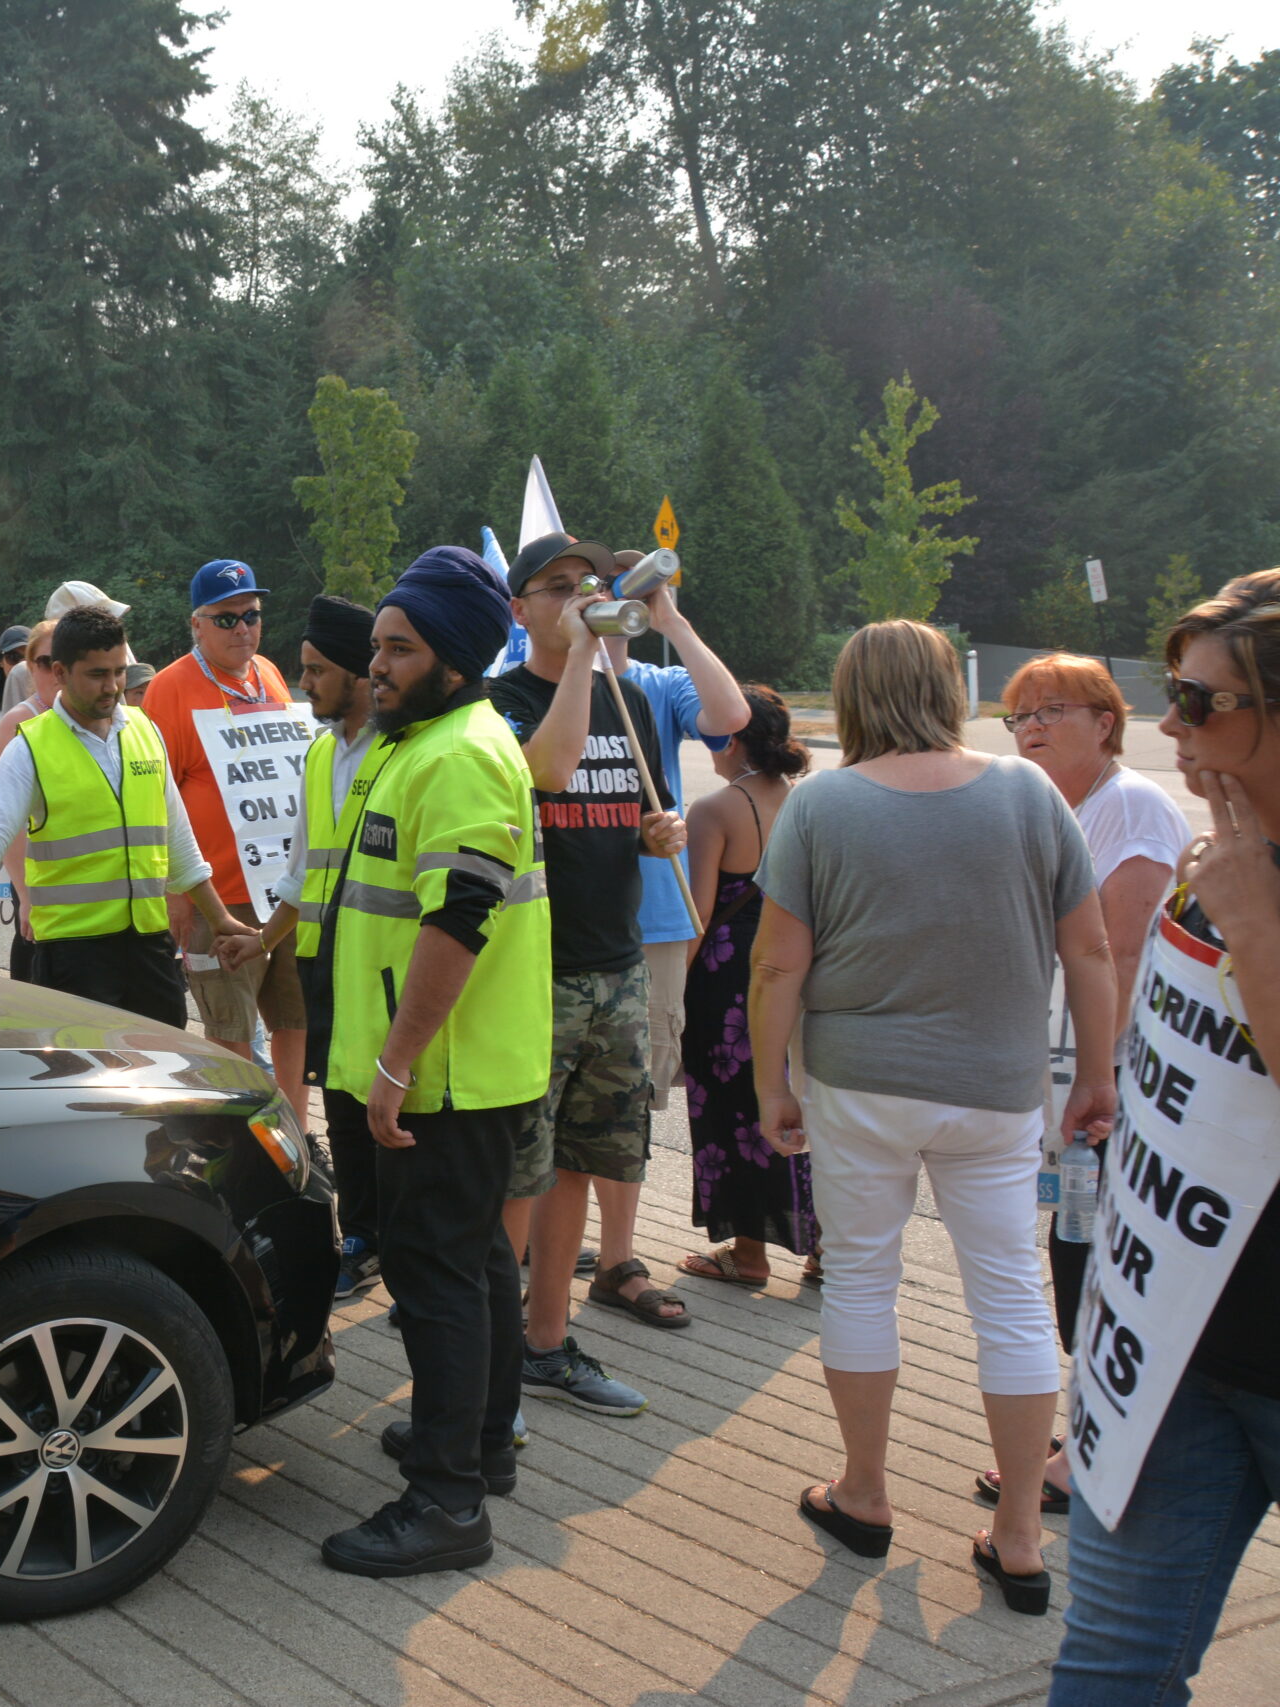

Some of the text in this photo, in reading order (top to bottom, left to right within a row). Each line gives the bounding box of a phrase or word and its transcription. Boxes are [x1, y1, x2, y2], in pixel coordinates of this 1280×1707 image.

[220, 721, 312, 749] WHERE
[581, 734, 635, 760] OAST
[227, 754, 308, 785] ARE Y
[590, 767, 640, 794] JOBS
[239, 796, 277, 822] ON
[540, 801, 584, 829] OUR
[585, 802, 640, 829] FUTU
[1148, 970, 1269, 1077] DRINK
[1107, 1200, 1154, 1298] UR
